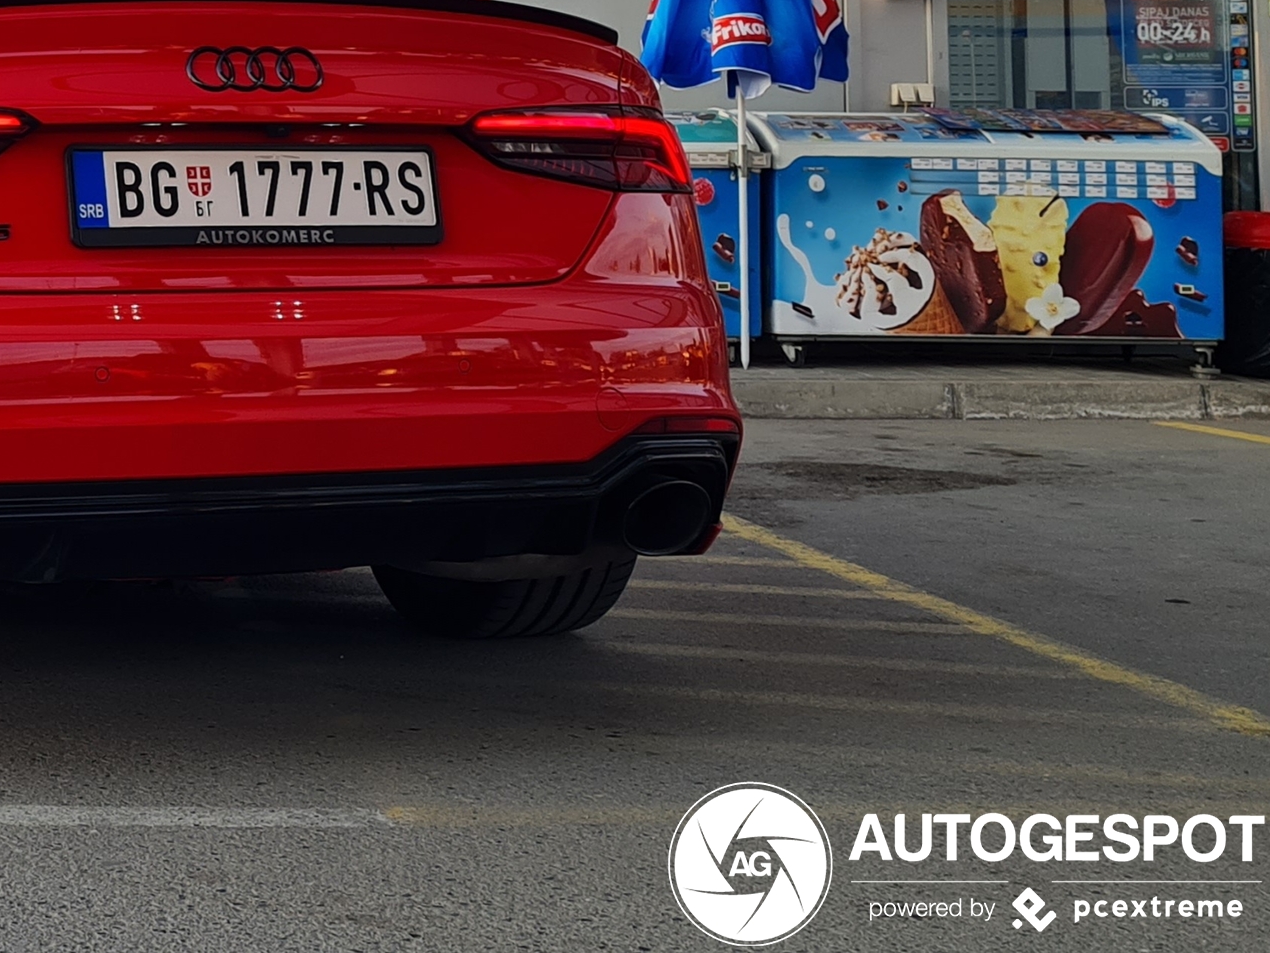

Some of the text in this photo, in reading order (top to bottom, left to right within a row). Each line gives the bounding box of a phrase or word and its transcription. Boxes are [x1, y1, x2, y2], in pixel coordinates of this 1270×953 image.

[1172, 6, 1210, 17] DANAS
[1151, 97, 1169, 107] IPS
[114, 161, 180, 218] BG
[79, 203, 105, 218] SRB
[196, 229, 335, 244] AUTOKOMERC
